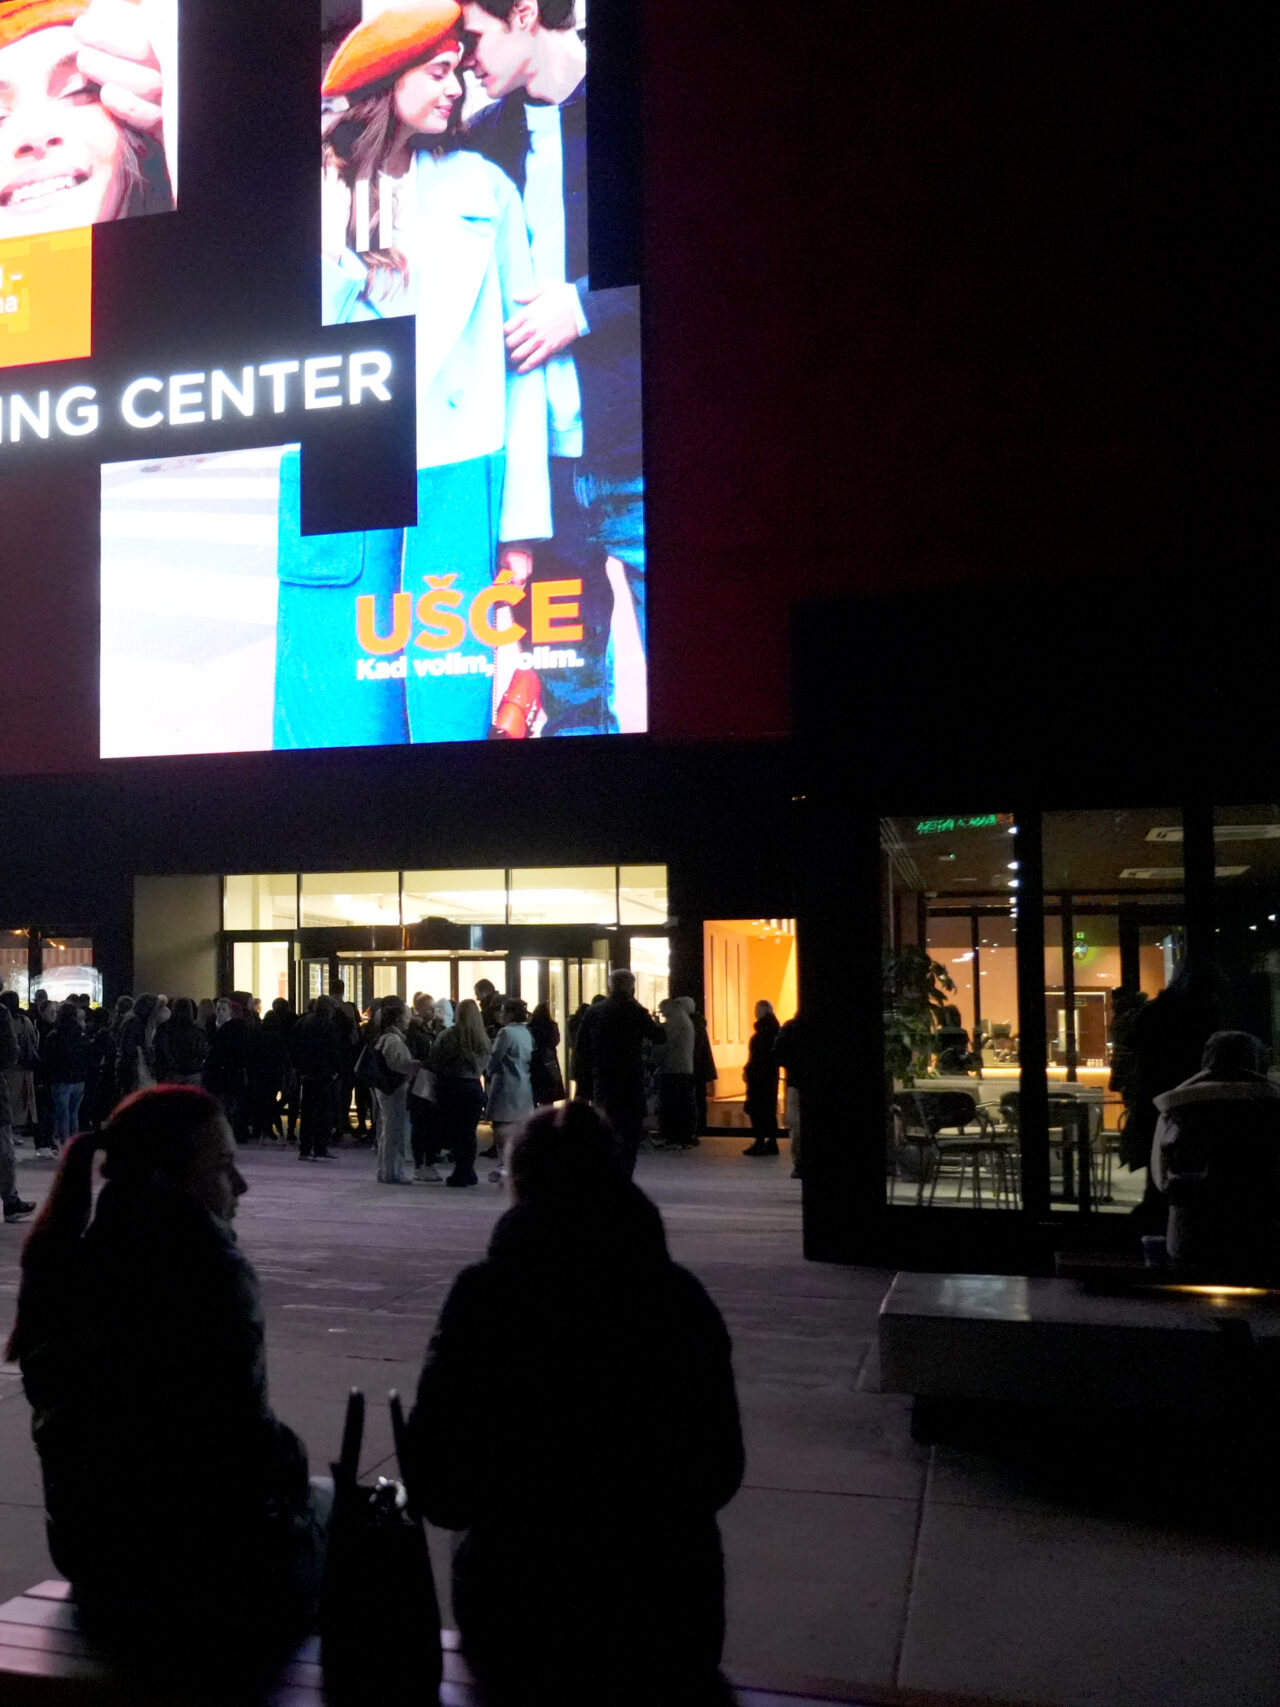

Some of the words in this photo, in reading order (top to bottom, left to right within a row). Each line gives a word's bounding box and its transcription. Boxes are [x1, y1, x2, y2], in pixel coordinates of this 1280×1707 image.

[121, 350, 394, 429] CENTER
[356, 569, 584, 655] UŠĆE
[356, 656, 408, 681] Kad
[413, 652, 494, 677] volim,
[504, 646, 584, 671] olim.
